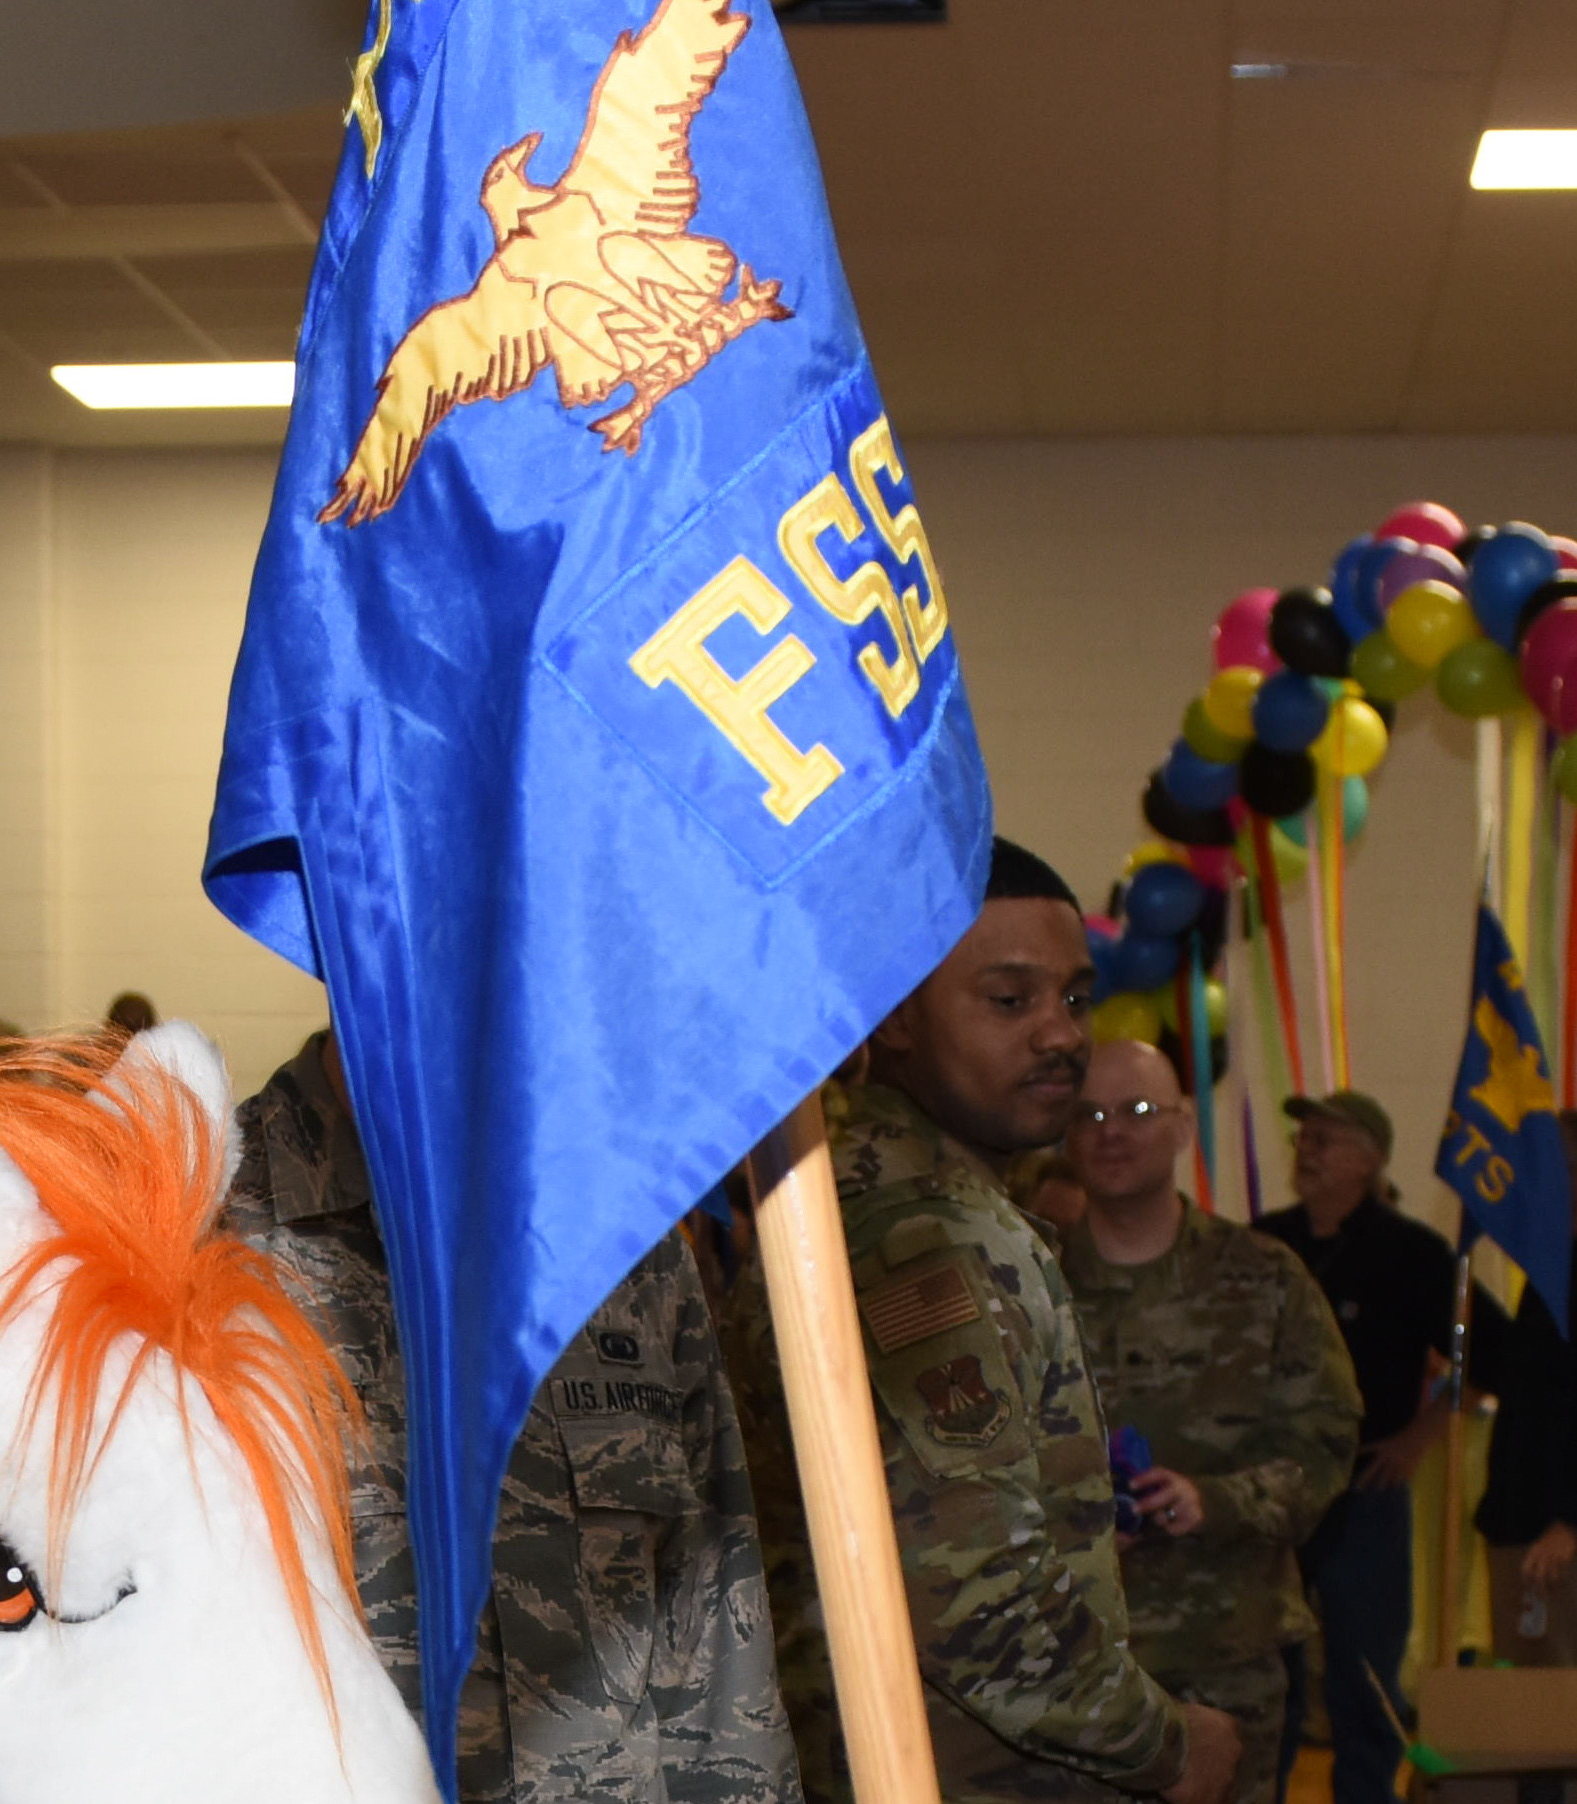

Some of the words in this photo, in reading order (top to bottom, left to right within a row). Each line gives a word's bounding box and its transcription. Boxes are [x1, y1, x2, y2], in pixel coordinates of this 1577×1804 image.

[629, 413, 948, 826] FSS
[563, 1380, 603, 1411] U.S.
[605, 1381, 638, 1412] AIR
